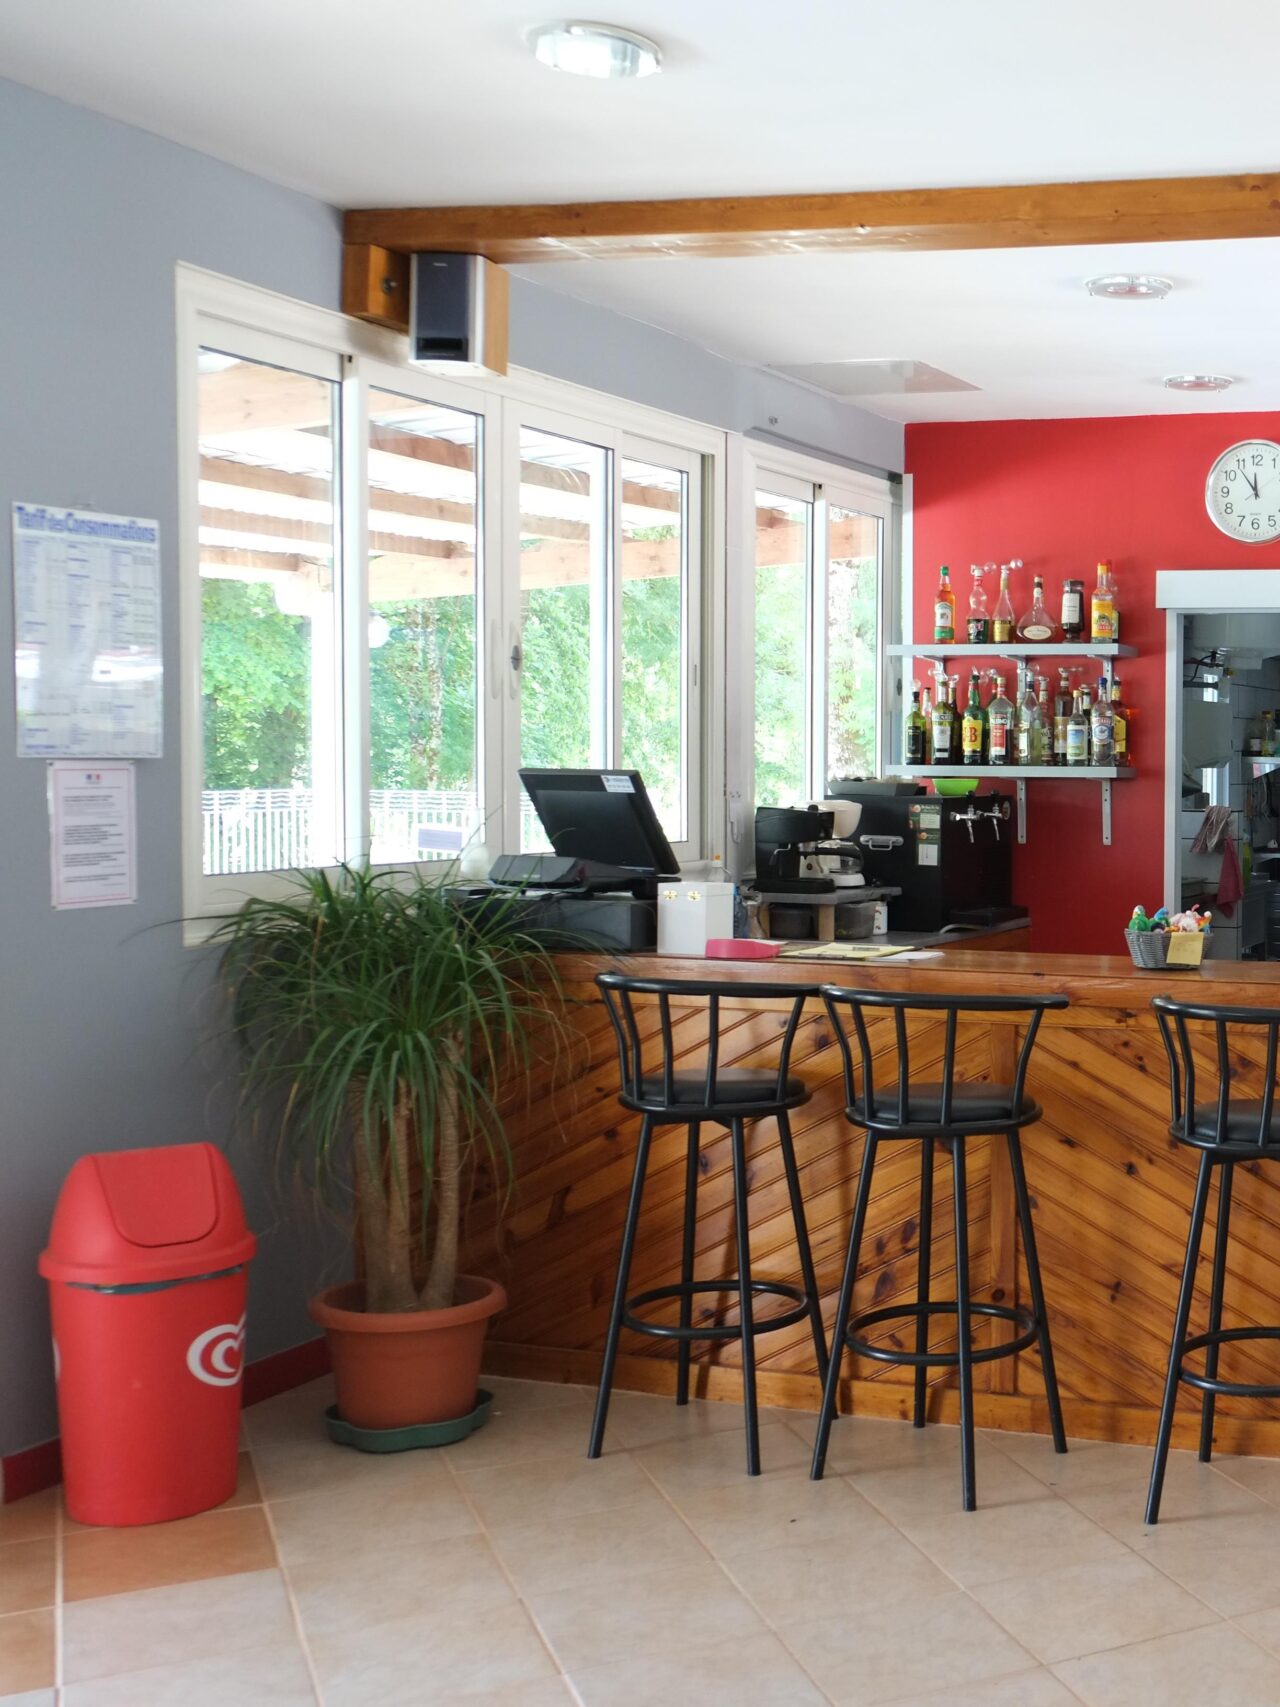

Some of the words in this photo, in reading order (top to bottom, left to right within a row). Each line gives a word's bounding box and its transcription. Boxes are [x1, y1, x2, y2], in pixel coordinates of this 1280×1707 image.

[1236, 458, 1246, 470] 11
[1251, 454, 1263, 466] 12
[1224, 469, 1237, 482] 10
[1220, 486, 1230, 498] 9
[1224, 502, 1234, 515] 8
[16, 506, 46, 531] Tarif
[1237, 515, 1246, 527] 7
[1251, 517, 1260, 530] 6
[1267, 515, 1277, 528] 5
